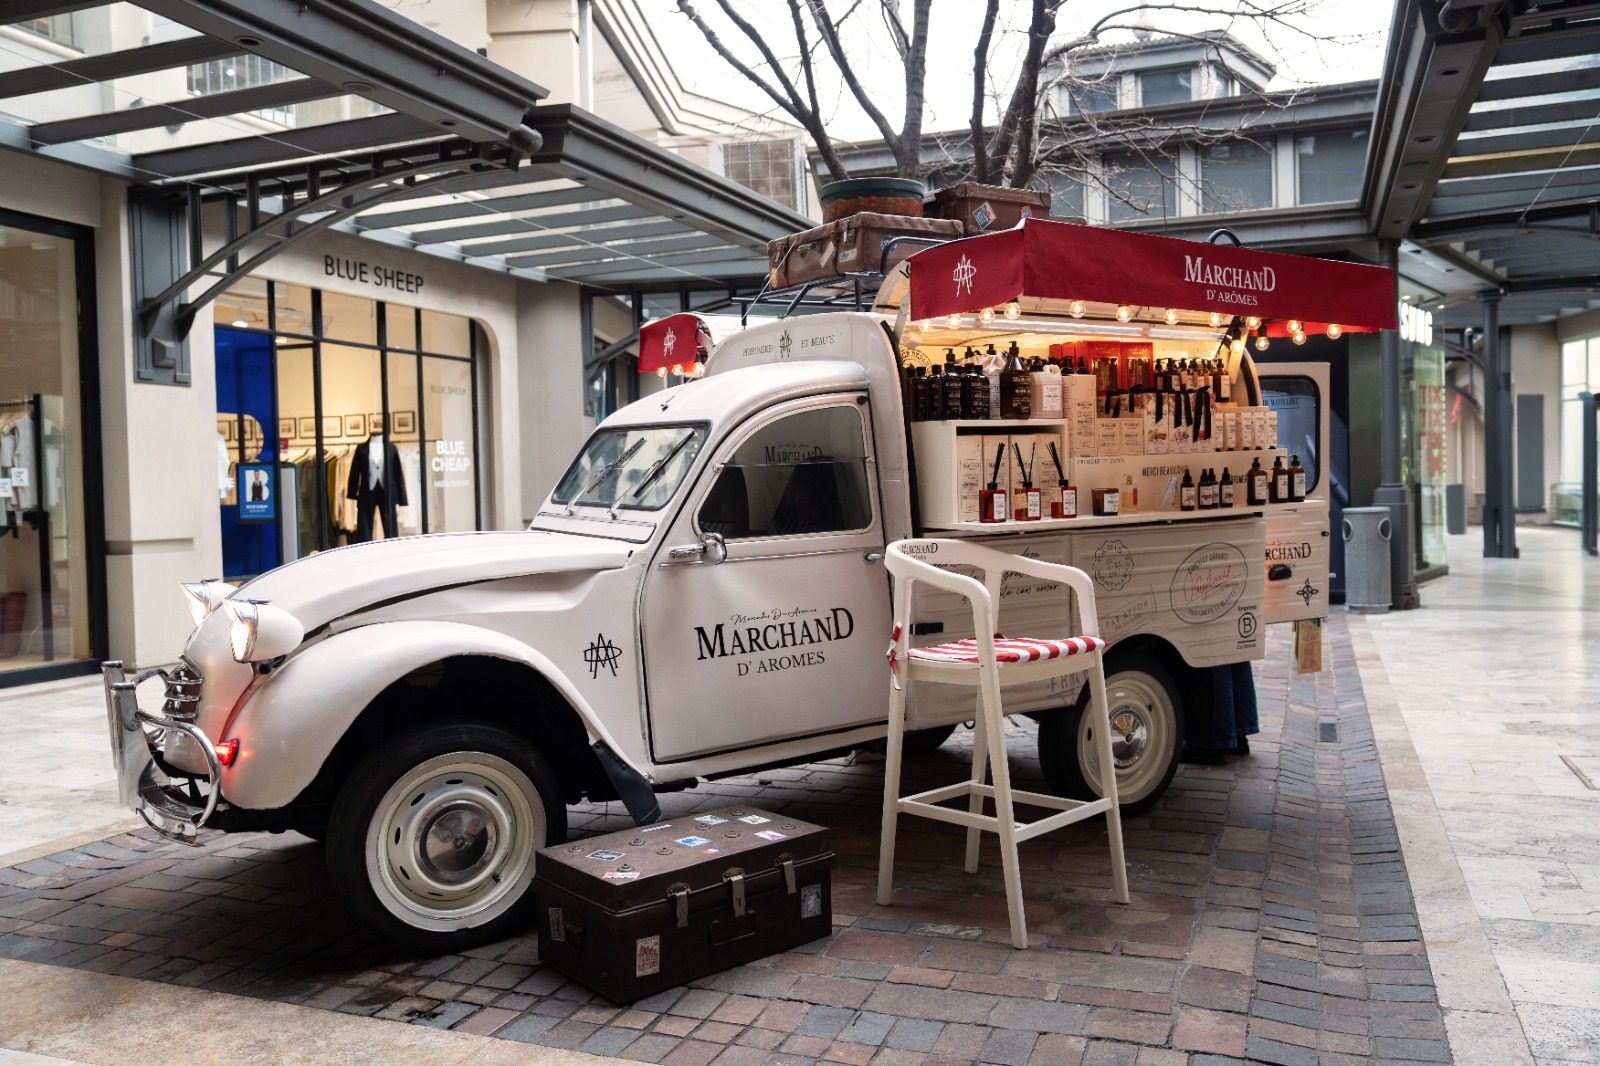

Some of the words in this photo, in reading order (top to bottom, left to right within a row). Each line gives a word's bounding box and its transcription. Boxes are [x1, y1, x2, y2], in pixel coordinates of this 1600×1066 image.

[324, 255, 368, 283] BLUE
[374, 266, 424, 294] SHEEP
[1184, 255, 1276, 292] MARCHAND
[1401, 302, 1433, 347] SUNG
[430, 384, 445, 395] BLUE
[447, 386, 467, 396] SHEEP
[436, 440, 466, 456] BLUE
[431, 456, 471, 472] CHEAP
[1265, 542, 1312, 561] RCHAND
[693, 607, 854, 661] MARCHAND
